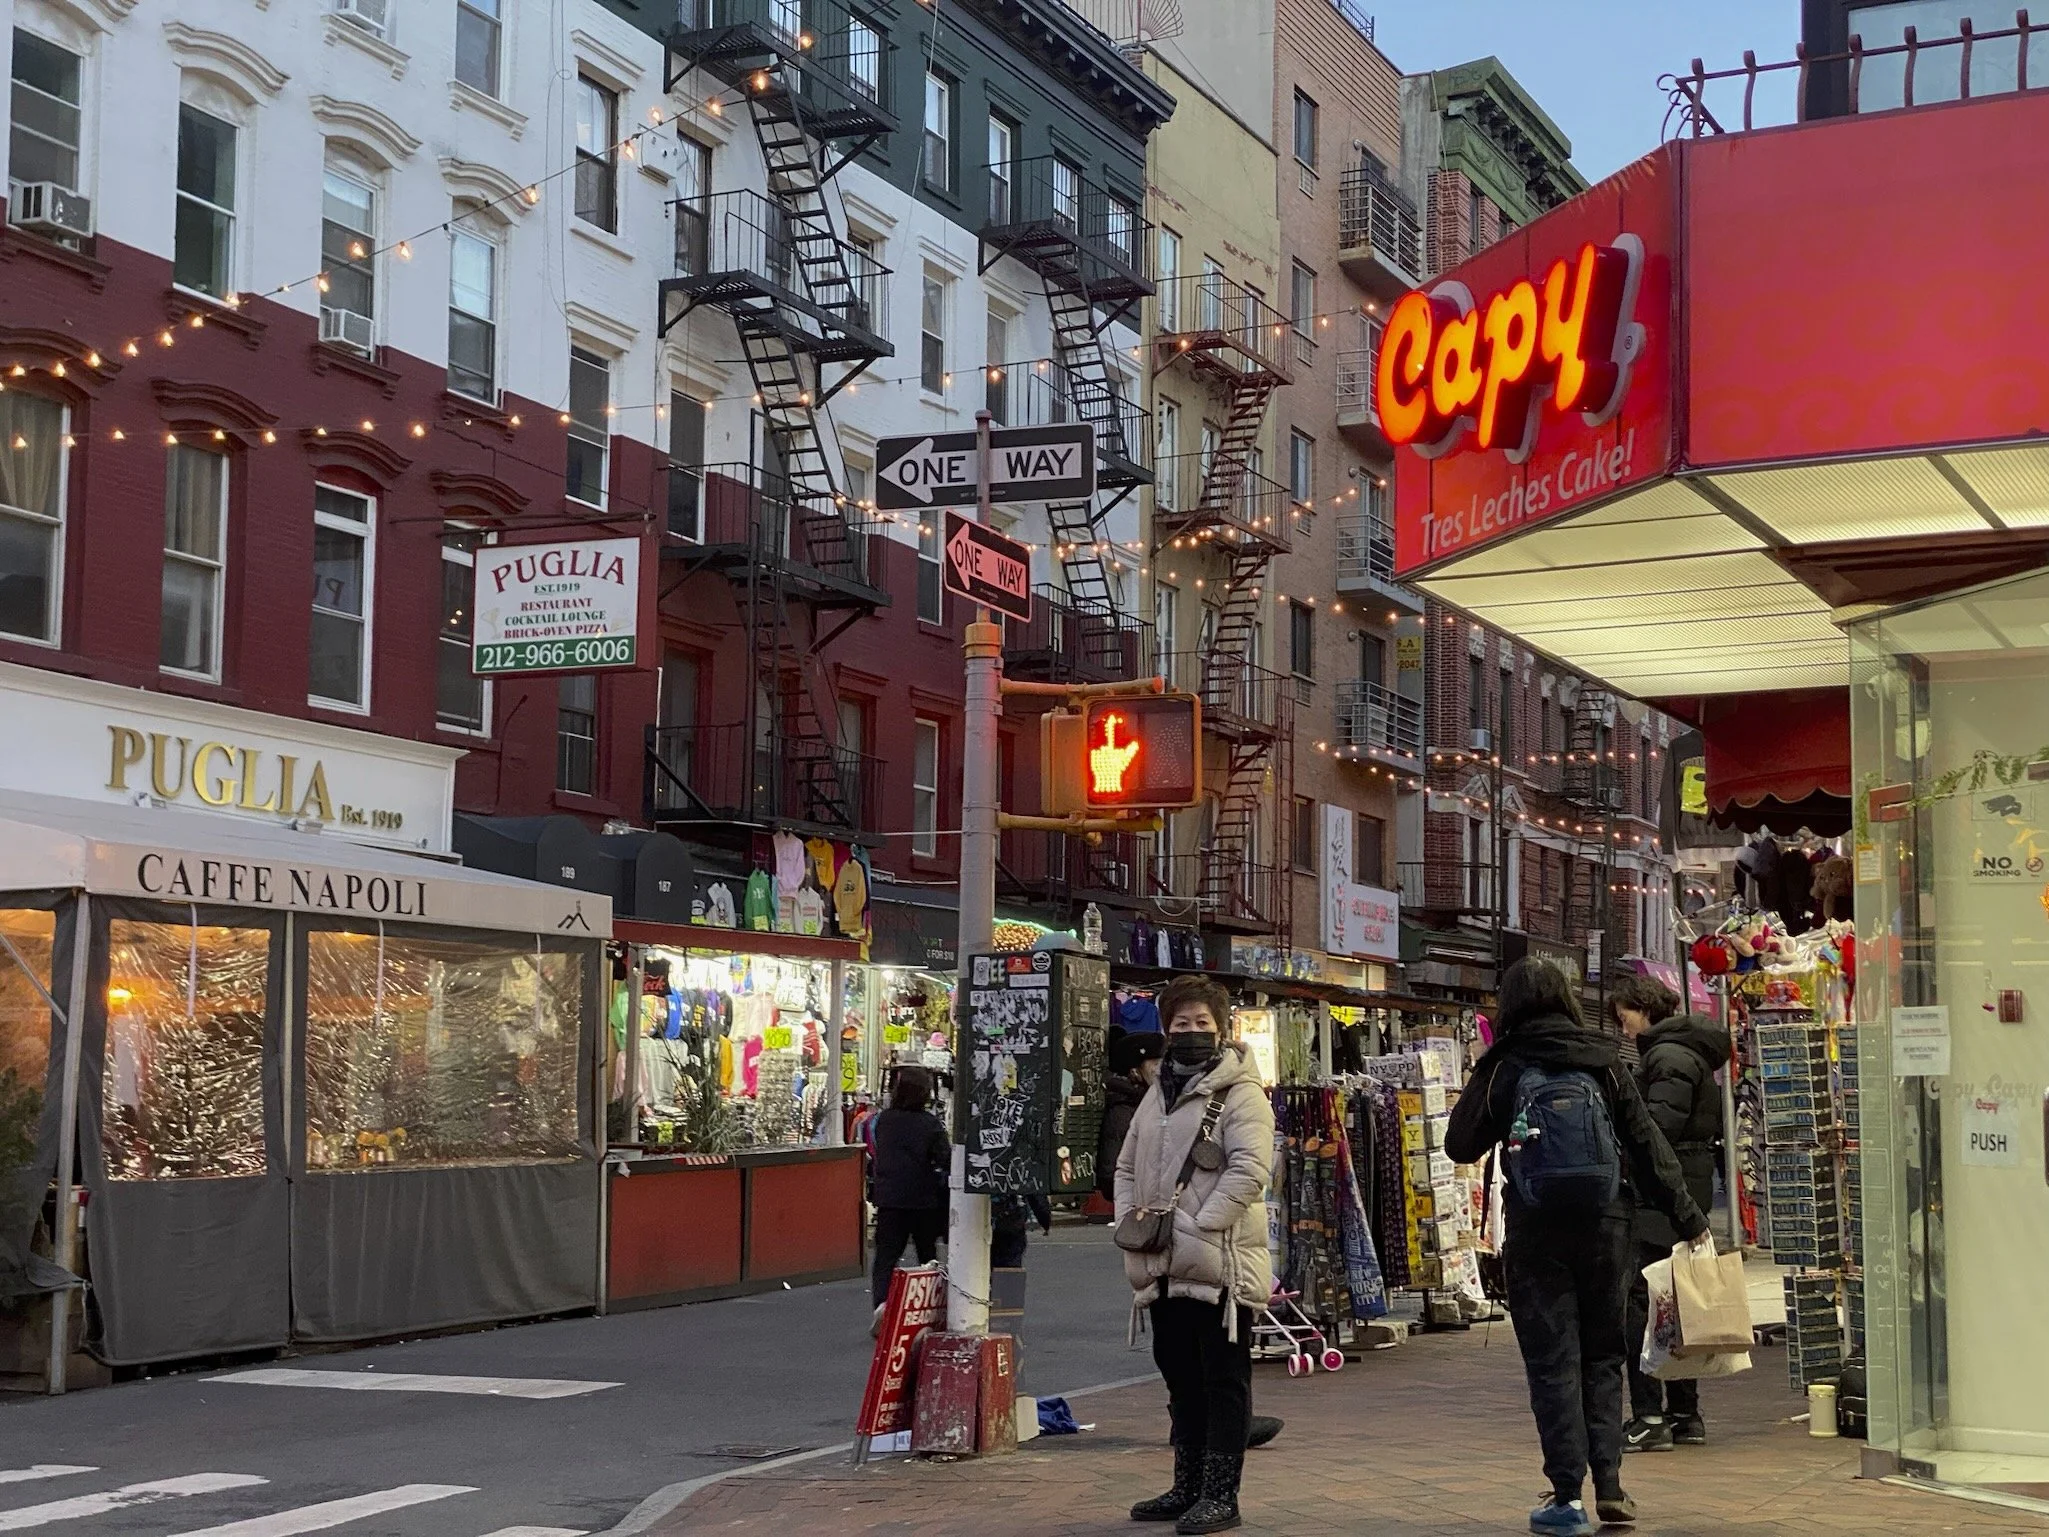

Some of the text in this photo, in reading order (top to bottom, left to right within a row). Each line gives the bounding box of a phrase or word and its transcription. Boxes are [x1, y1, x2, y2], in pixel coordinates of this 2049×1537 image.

[1377, 241, 1596, 449] Capy
[899, 448, 1073, 486] ONE WAY
[1421, 428, 1634, 556] Tres Leches Cake!
[491, 549, 625, 593] PUGLIA
[954, 540, 1023, 593] ONE WAY
[505, 611, 606, 627] COCKTAIL LOUNGE
[520, 598, 593, 612] RESTAURANT
[504, 623, 608, 639] BRICK-OVEN PIZZA
[481, 639, 630, 669] 212-966-6006
[105, 725, 403, 830] PUGLIA Est. 1919
[1973, 869, 2022, 878] SMOKING
[1982, 857, 2012, 869] NO
[137, 853, 426, 916] CAFFE NAPOLI
[658, 881, 672, 893] 187
[1971, 1132, 2007, 1152] PUSH
